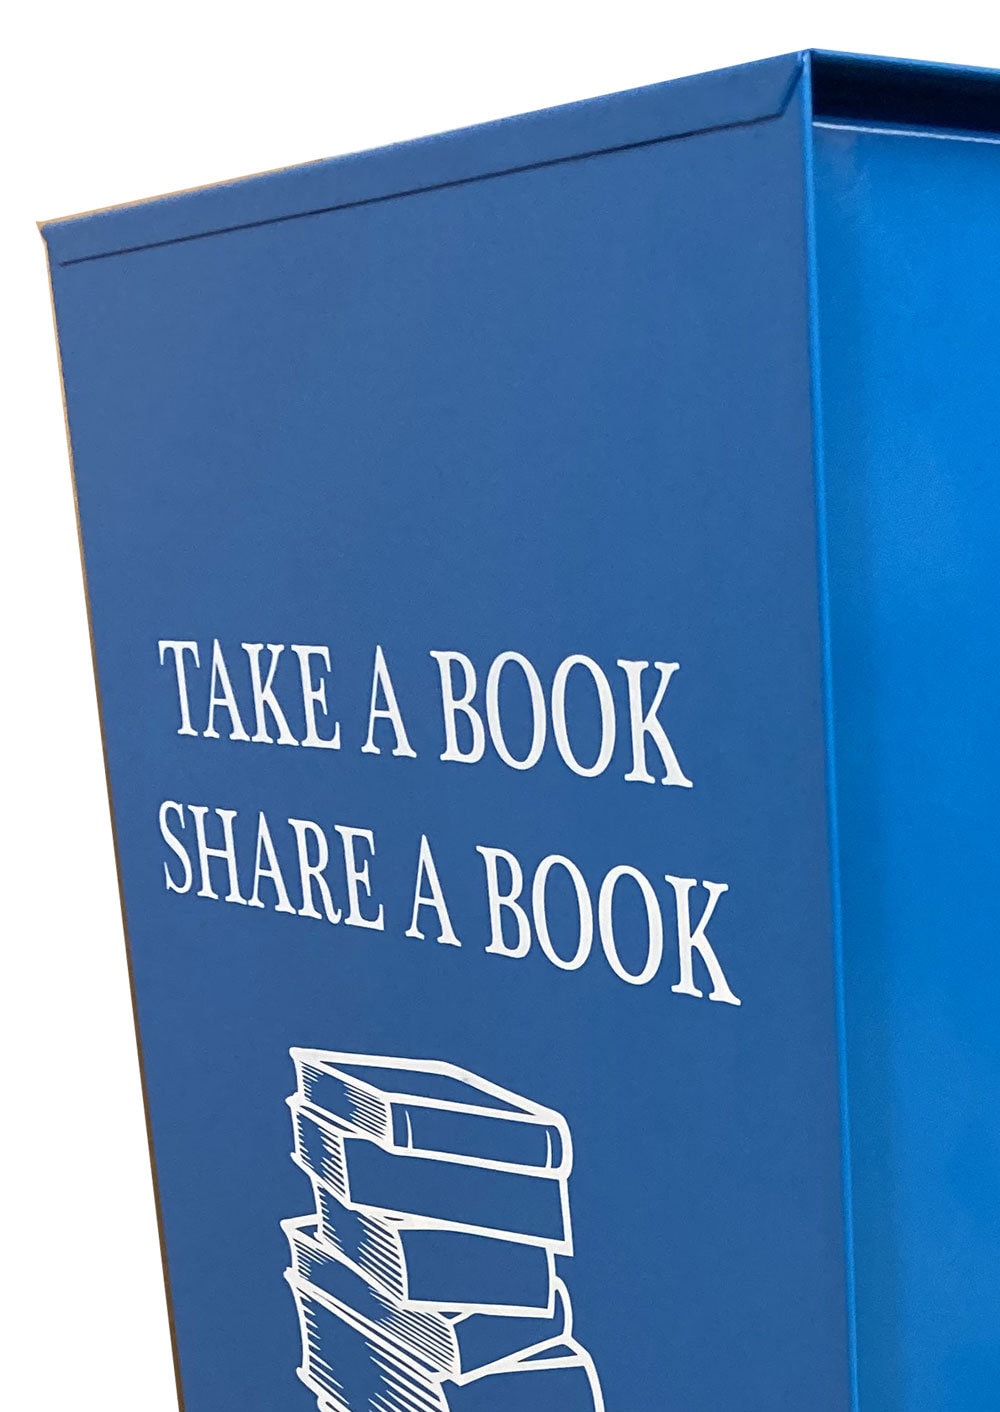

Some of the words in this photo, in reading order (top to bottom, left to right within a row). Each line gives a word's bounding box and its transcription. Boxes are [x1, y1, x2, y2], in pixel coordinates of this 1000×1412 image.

[158, 637, 341, 751] TAKE
[361, 645, 417, 758] A
[430, 650, 693, 789] BOOK
[159, 800, 385, 931] SHARE
[405, 834, 462, 948] A
[476, 845, 742, 1006] BOOK
